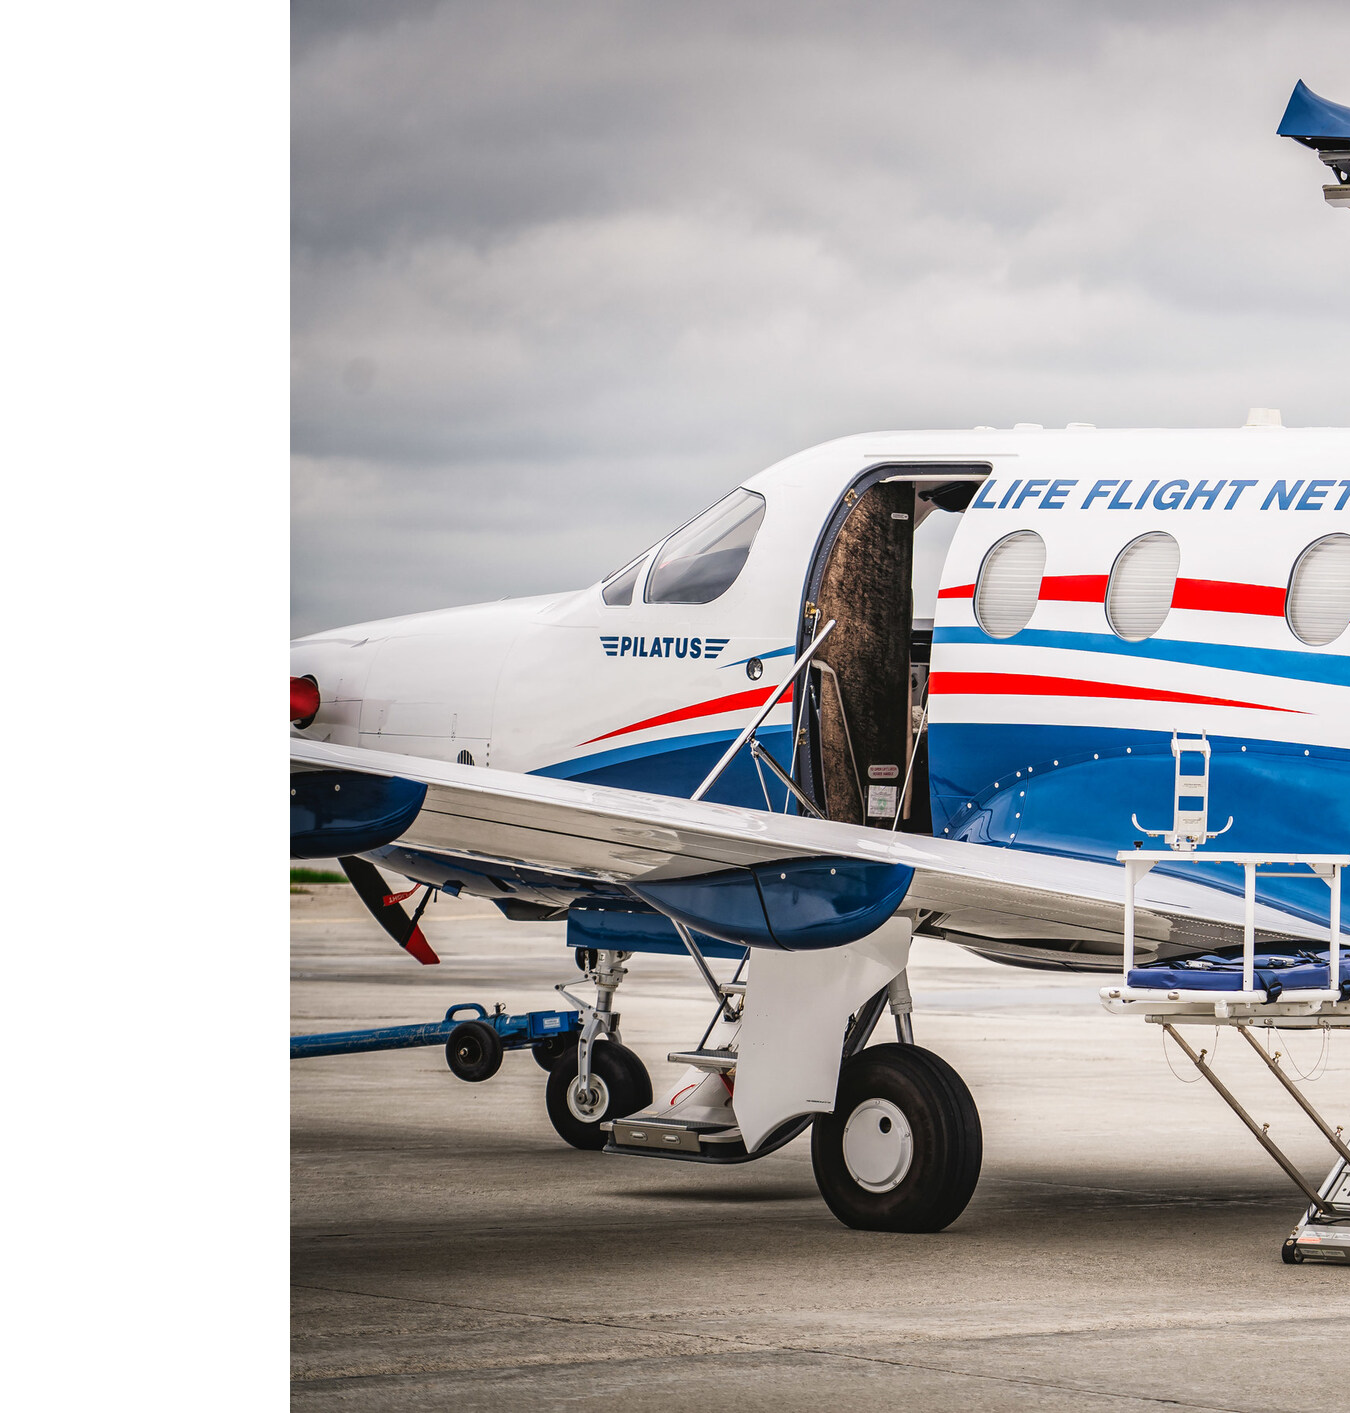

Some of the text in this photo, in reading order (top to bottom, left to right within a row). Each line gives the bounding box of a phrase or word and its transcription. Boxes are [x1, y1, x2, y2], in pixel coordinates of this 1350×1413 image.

[971, 479, 1080, 510] LIFE
[1080, 479, 1259, 511] FLIGHT
[619, 636, 702, 659] PILATUS
